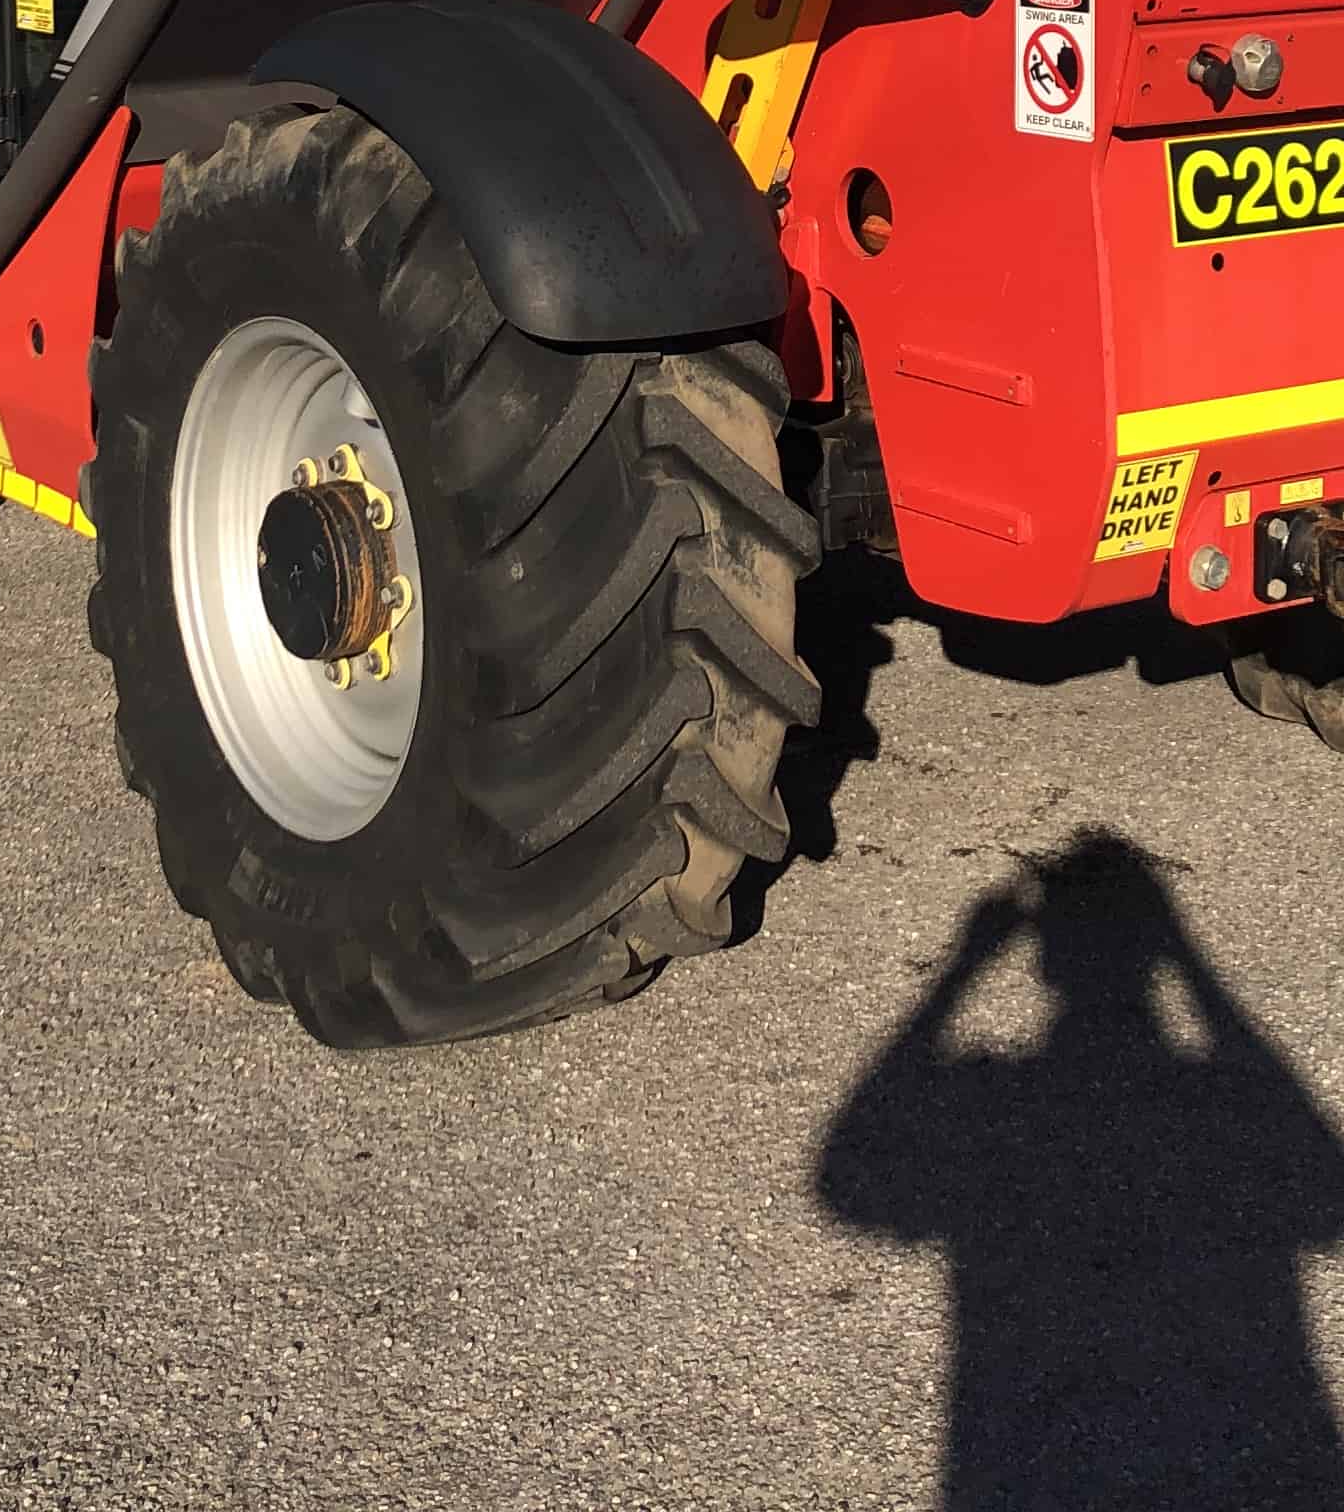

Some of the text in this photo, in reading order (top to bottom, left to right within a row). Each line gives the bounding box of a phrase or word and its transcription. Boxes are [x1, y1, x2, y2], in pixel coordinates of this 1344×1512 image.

[1025, 10, 1084, 25] SWING AREA
[1026, 114, 1084, 131] KEEP CLEAR
[1122, 459, 1183, 487] LEFT
[1110, 486, 1179, 515] HAND
[1101, 510, 1175, 542] DRIVE
